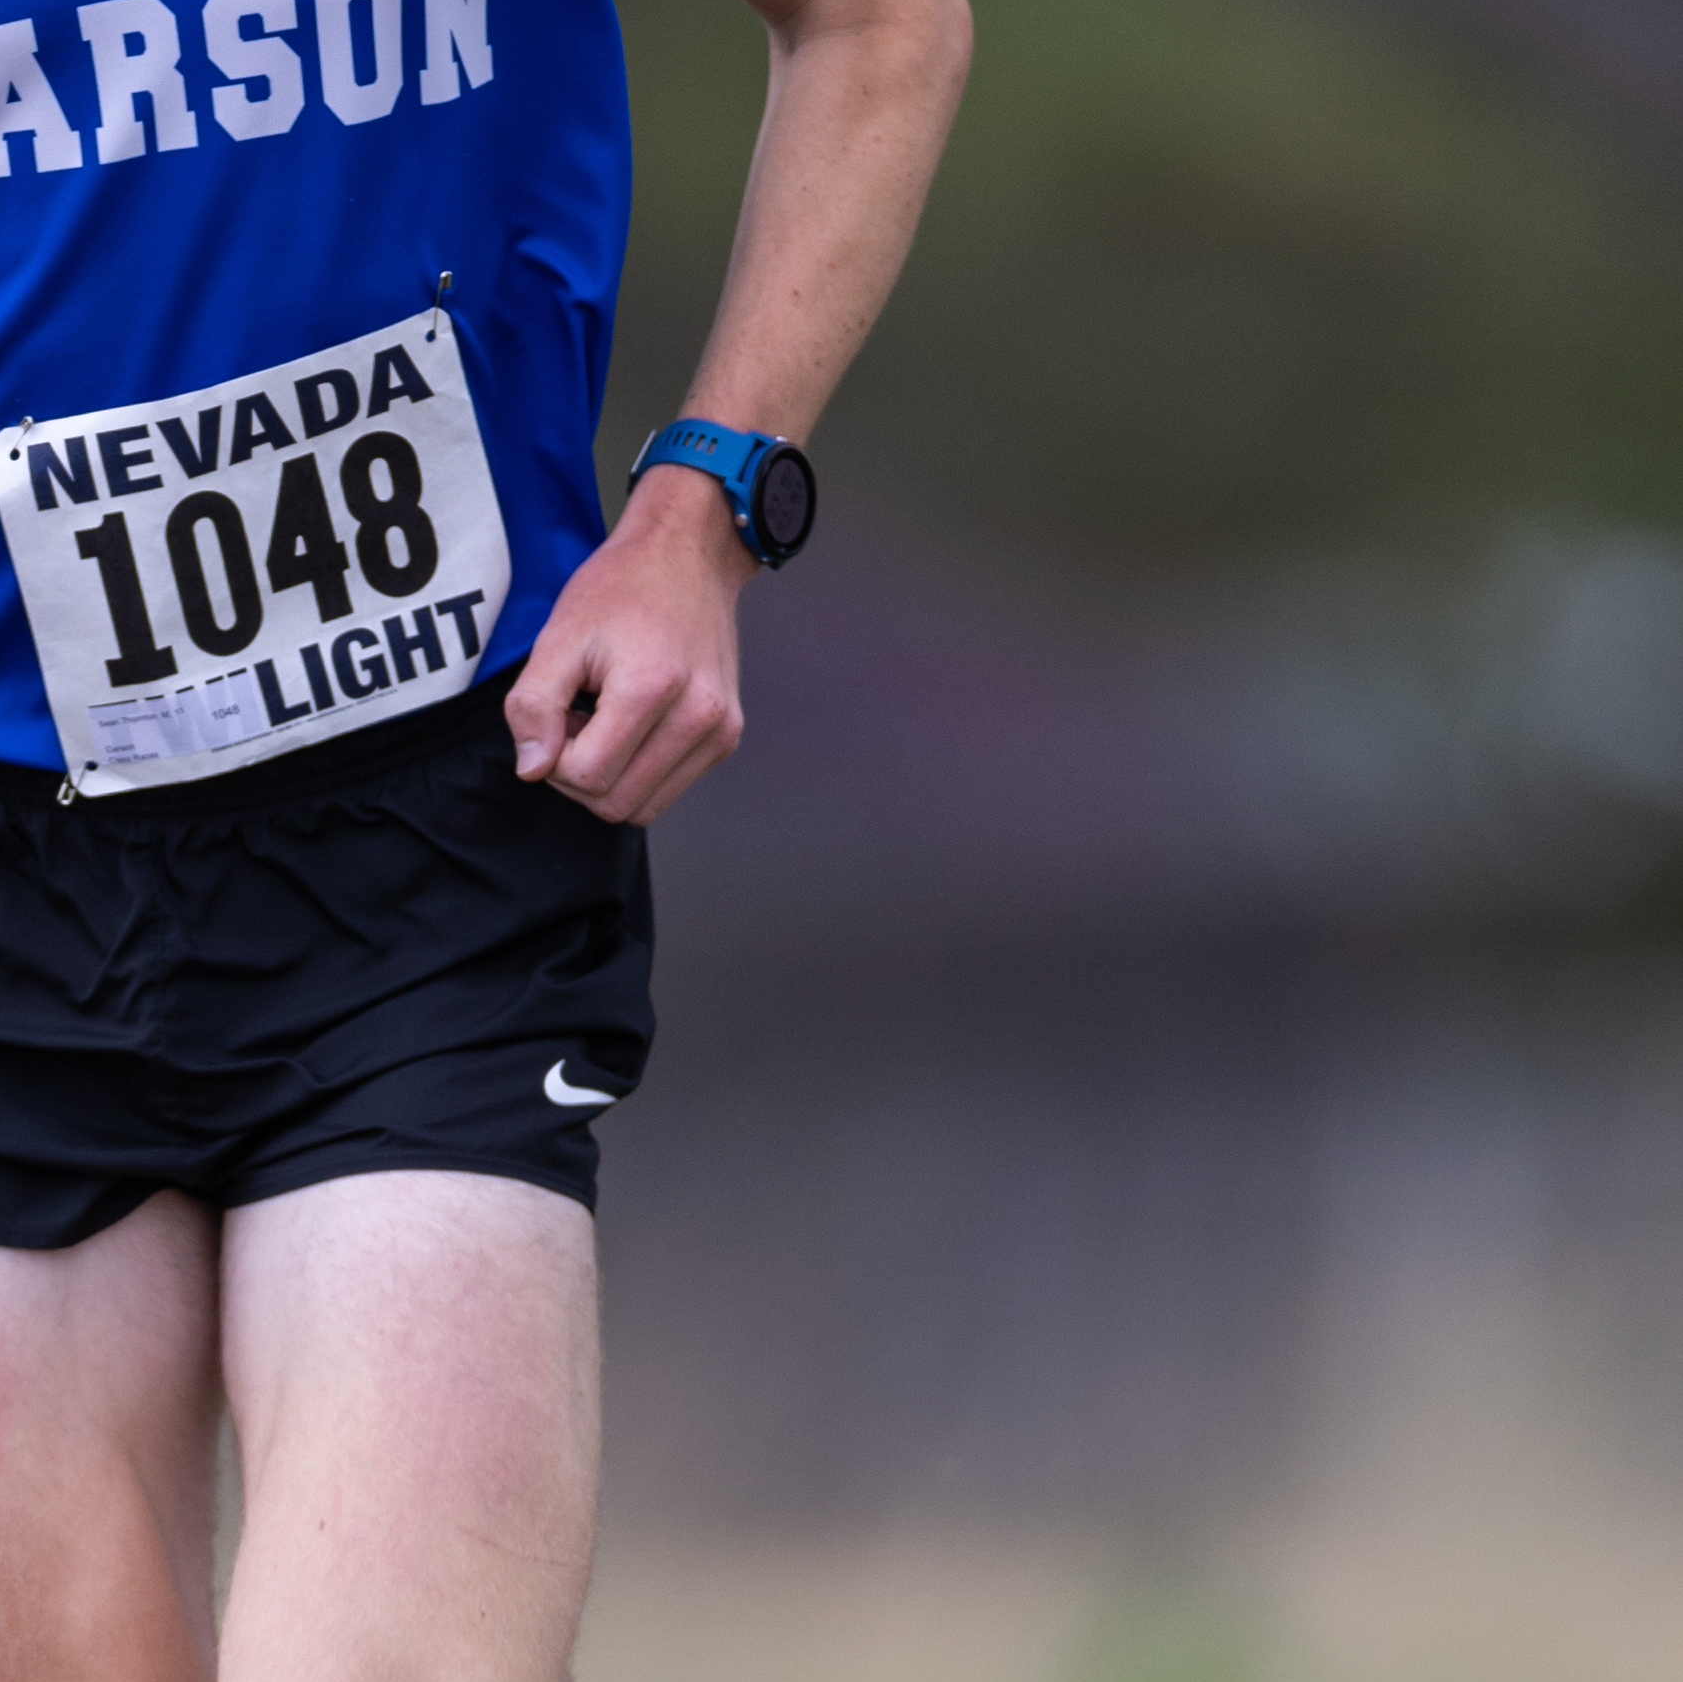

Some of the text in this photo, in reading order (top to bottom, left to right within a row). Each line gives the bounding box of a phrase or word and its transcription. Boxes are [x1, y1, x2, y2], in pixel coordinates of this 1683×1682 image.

[27, 344, 435, 512] NEVADA
[74, 430, 439, 689] 1048
[105, 744, 135, 754] Carson
[212, 703, 240, 721] 1048
